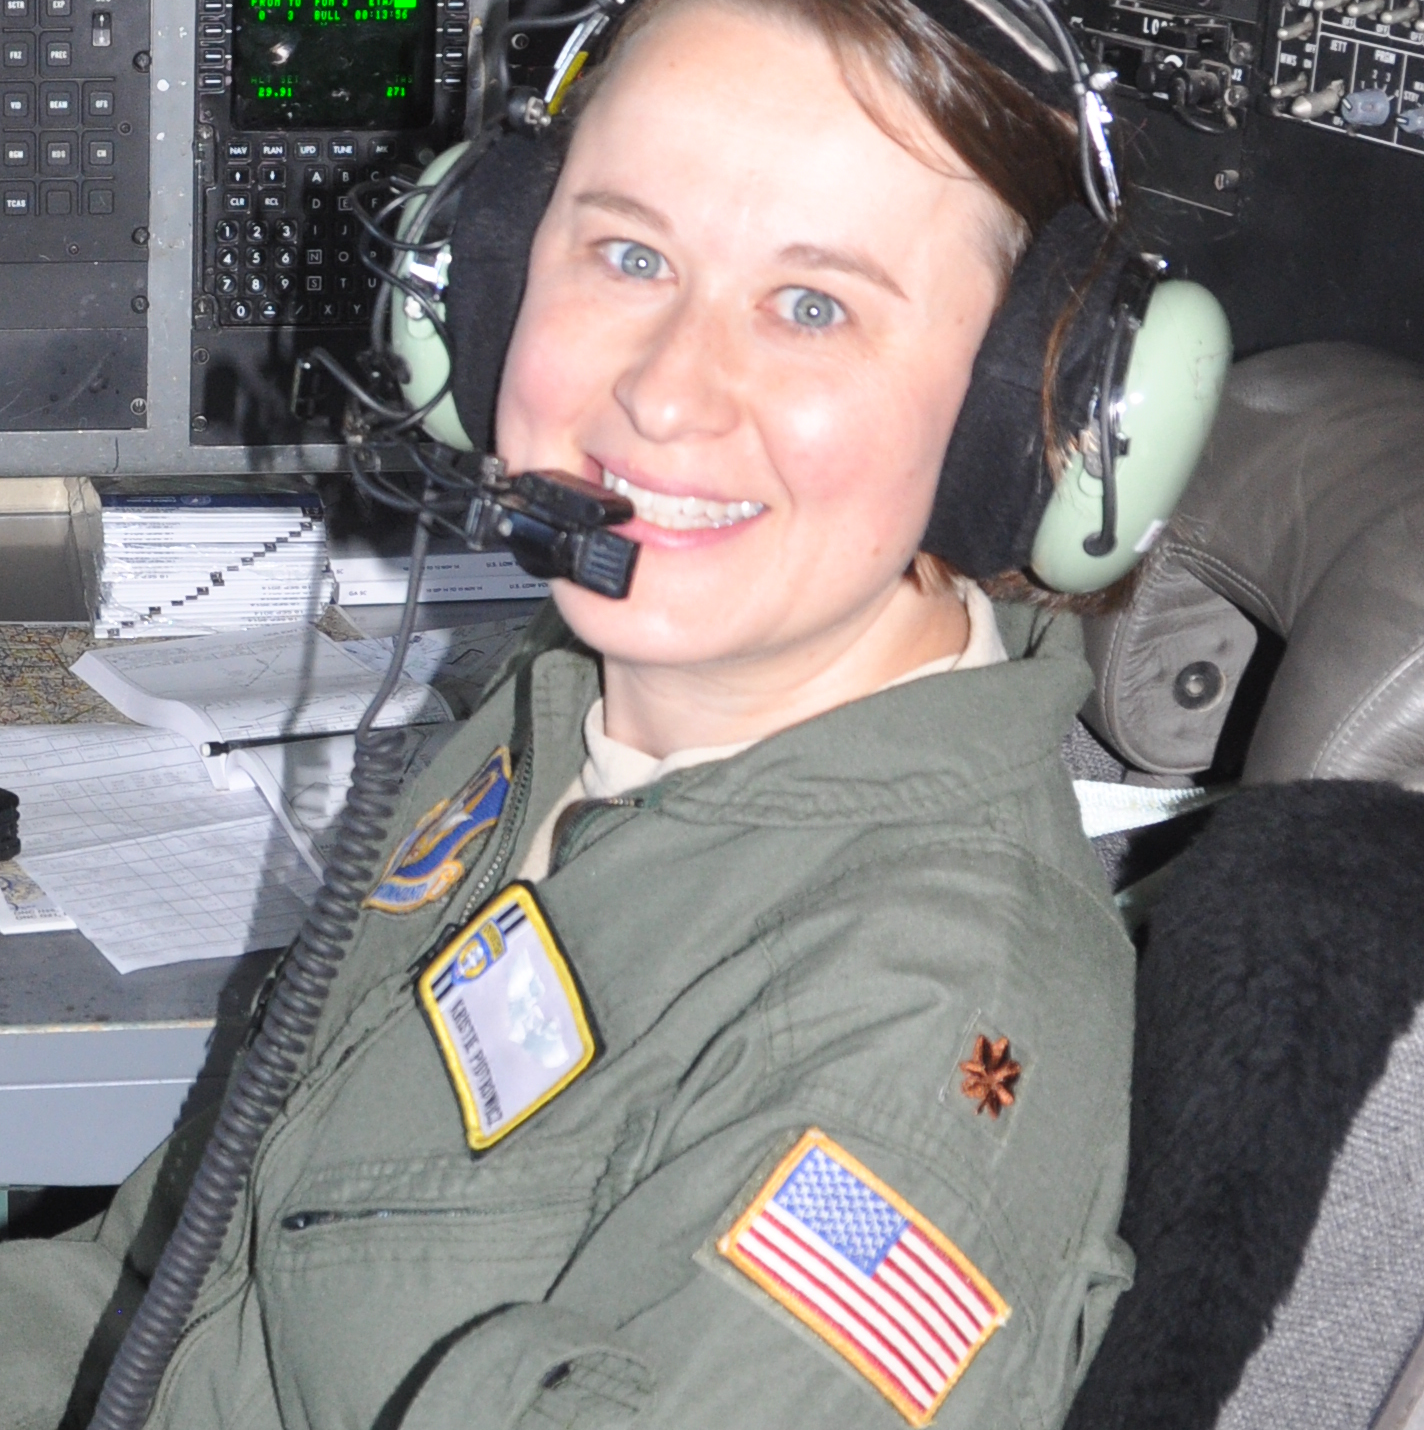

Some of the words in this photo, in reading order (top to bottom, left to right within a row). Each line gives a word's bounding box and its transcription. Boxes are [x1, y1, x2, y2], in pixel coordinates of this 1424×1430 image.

[314, 10, 341, 21] BULL
[354, 9, 408, 20] 00:13:56
[258, 87, 293, 97] 29.91
[386, 86, 406, 97] 271
[229, 146, 248, 155] NAV
[263, 145, 283, 155] PLAN
[332, 145, 353, 154] TUNE
[6, 199, 26, 208] TCAS
[229, 197, 245, 206] CLR
[451, 999, 478, 1052] KRISTIE
